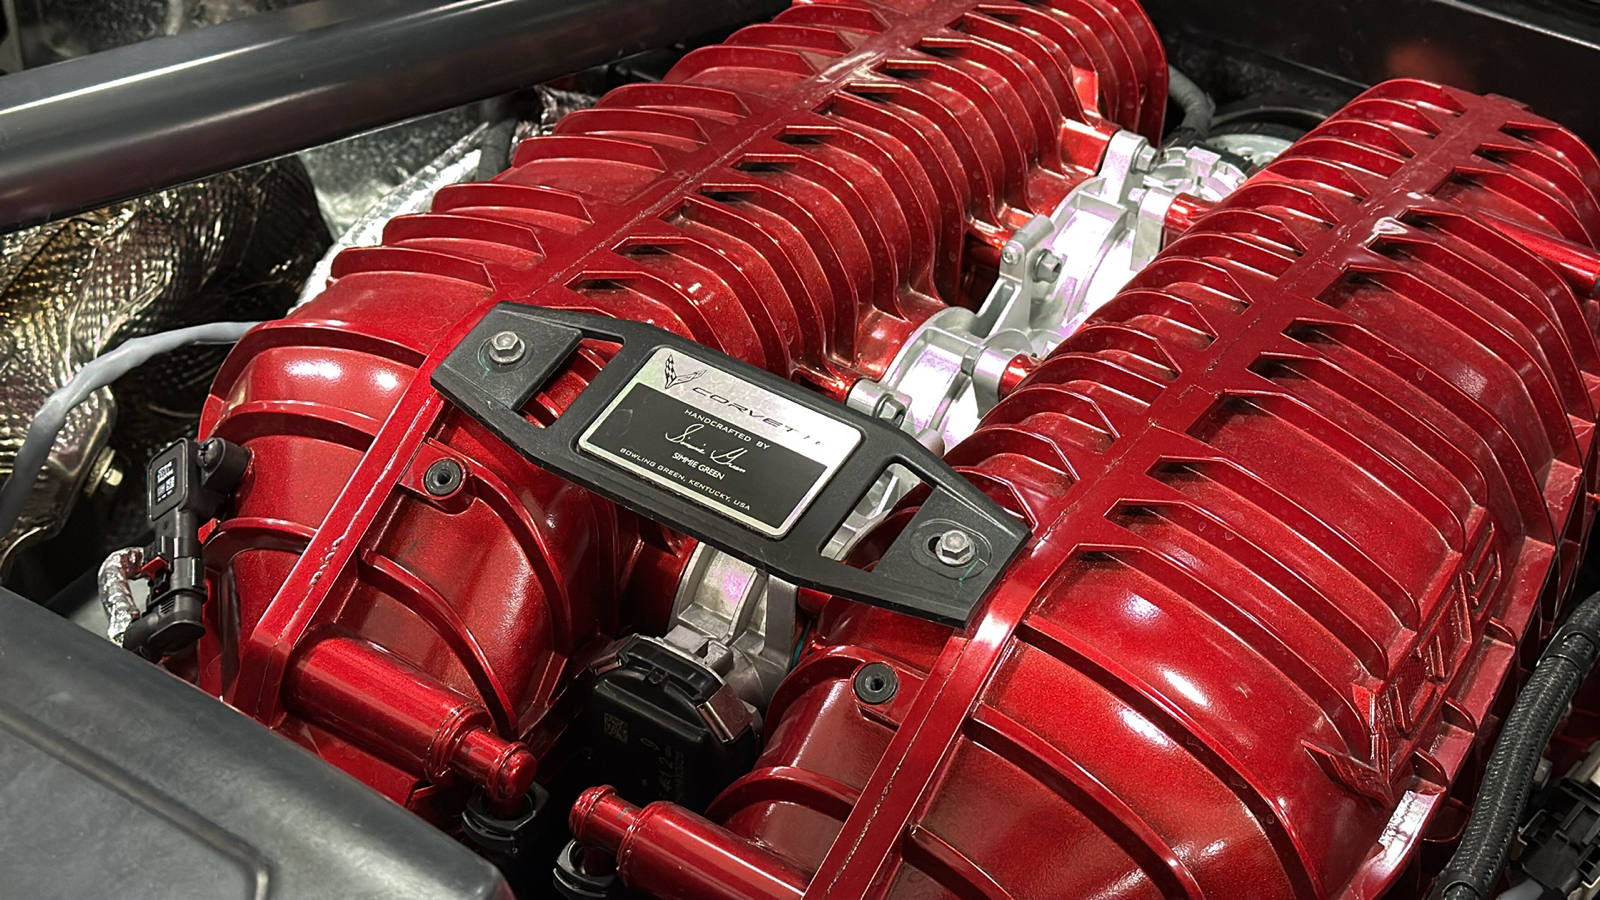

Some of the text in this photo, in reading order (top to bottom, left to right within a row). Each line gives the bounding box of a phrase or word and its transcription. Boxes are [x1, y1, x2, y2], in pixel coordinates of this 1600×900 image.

[684, 409, 771, 450] HANDCRAFTED BY
[692, 386, 822, 445] CORVET
[619, 447, 751, 511] BOWLING GREEN, KENTUCKY, USA
[672, 452, 726, 480] SIMMIE GREEN
